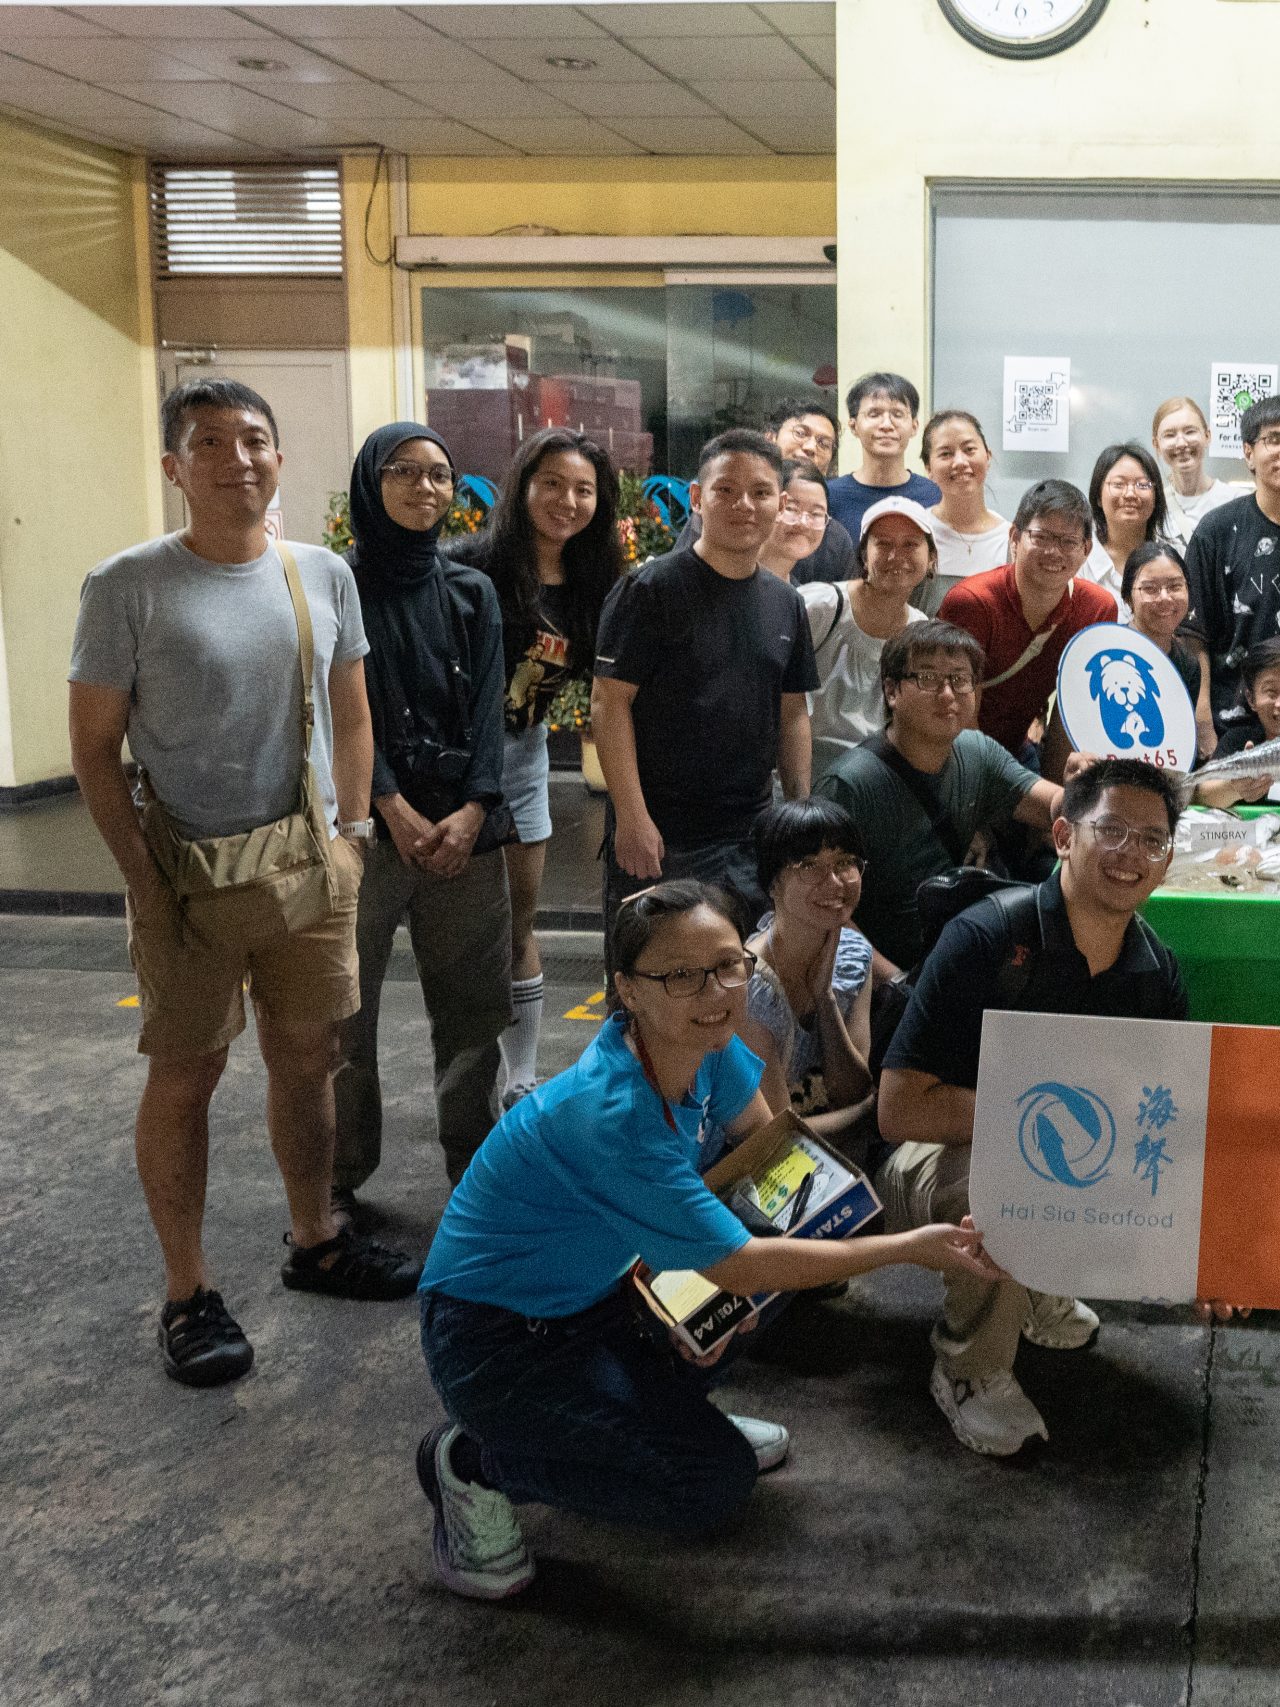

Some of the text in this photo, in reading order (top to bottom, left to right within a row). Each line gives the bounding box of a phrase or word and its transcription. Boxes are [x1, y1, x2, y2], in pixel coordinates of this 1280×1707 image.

[1200, 831, 1247, 841] STINGRAY
[1000, 1203, 1174, 1229] Hai Sia Seafood
[693, 1315, 714, 1340] A4
